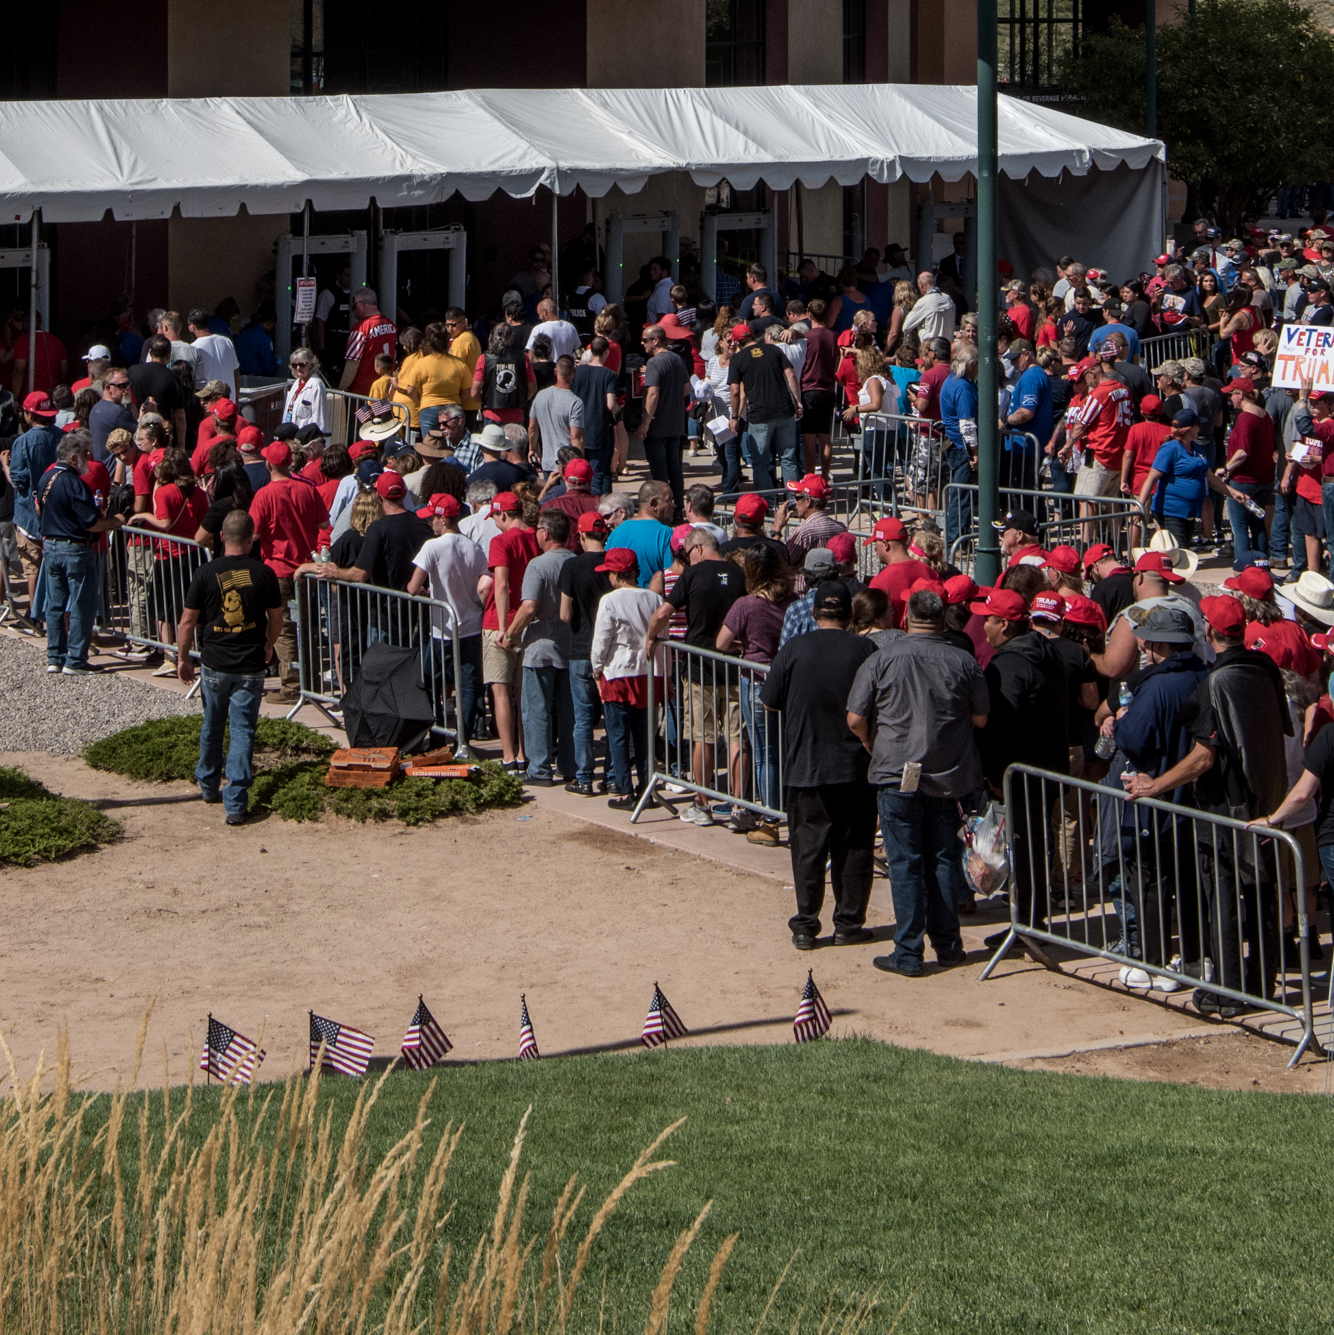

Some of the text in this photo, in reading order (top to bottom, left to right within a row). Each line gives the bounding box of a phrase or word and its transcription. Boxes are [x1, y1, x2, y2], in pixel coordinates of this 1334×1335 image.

[1032, 94, 1060, 102] BEVERAGE
[1304, 347, 1326, 356] FOR
[1036, 597, 1058, 606] TRUMP
